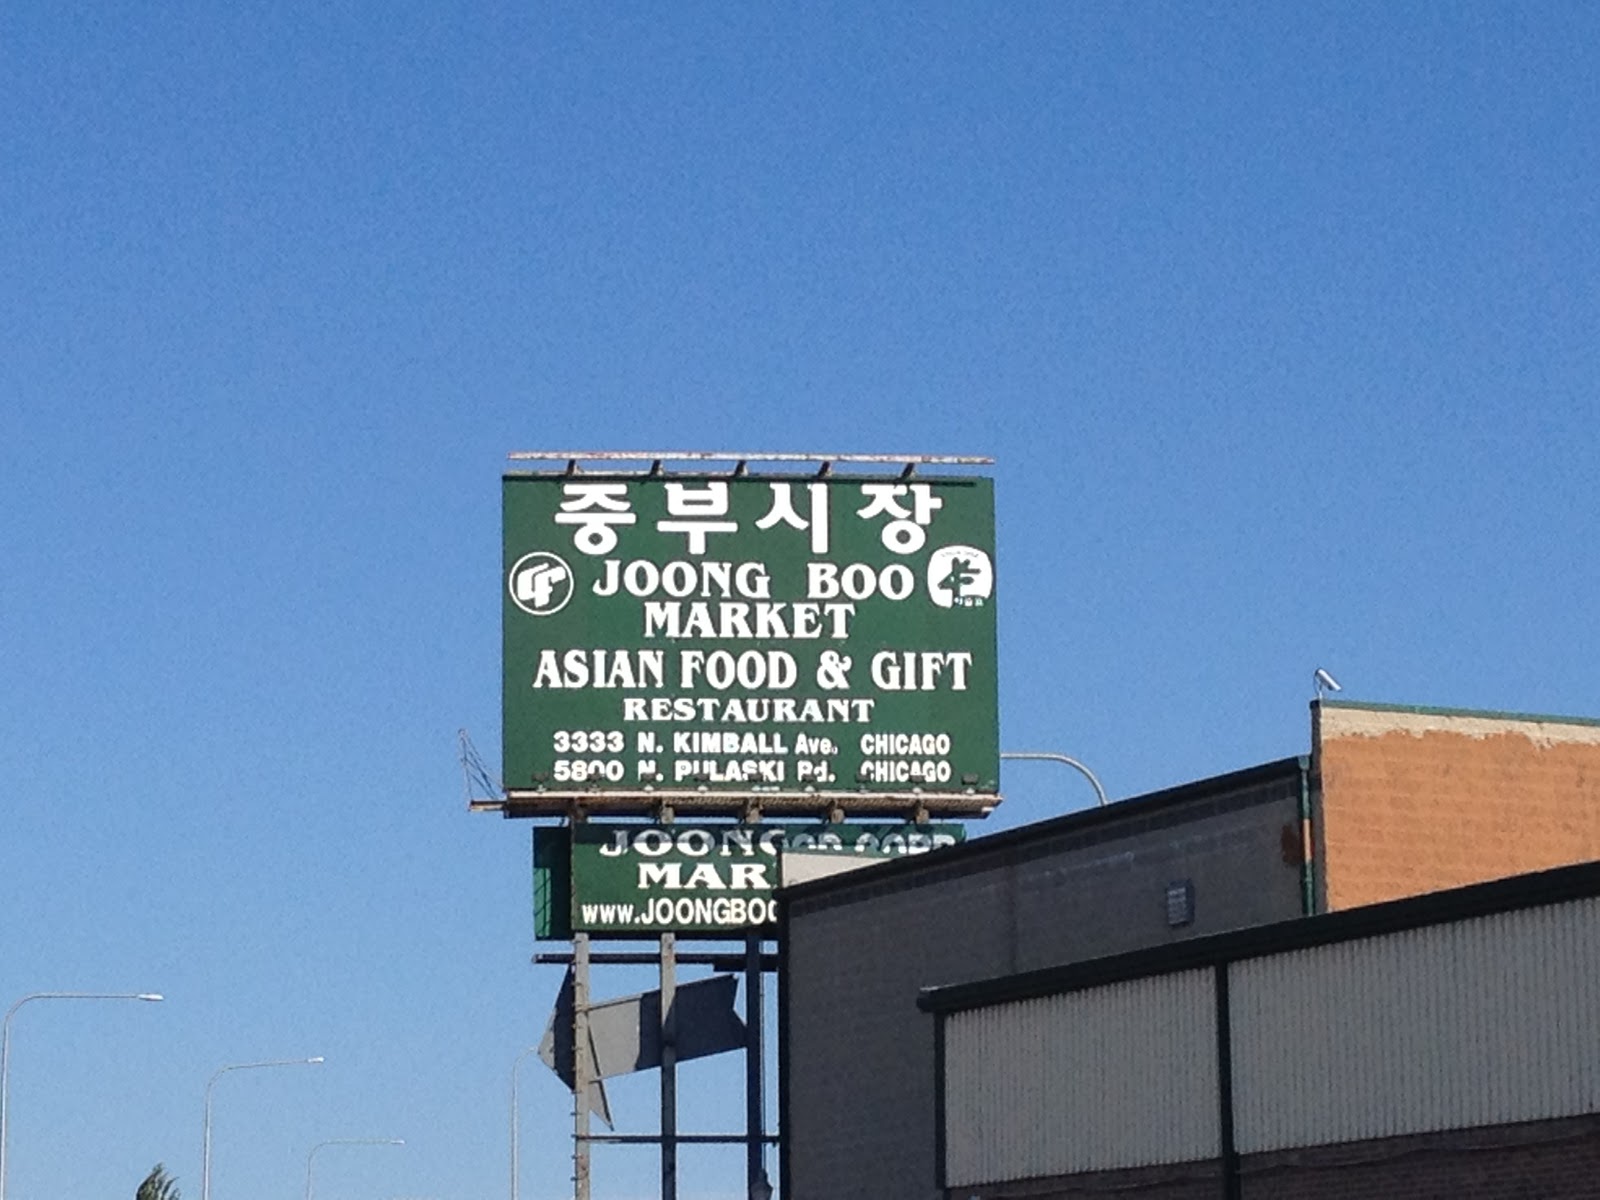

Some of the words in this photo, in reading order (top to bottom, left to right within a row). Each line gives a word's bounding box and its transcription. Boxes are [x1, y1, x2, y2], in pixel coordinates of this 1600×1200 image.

[554, 481, 944, 556] 중부시장
[592, 559, 771, 599] JOONG
[807, 562, 915, 601] BOO
[644, 601, 856, 639] MARKET
[532, 649, 664, 689] ASIAN
[680, 649, 797, 690] FOOD
[816, 649, 852, 690] &
[871, 650, 972, 691] GIFT
[623, 697, 875, 723] RESTAURANT
[553, 730, 625, 753] 3333
[637, 731, 664, 754] N.
[673, 731, 789, 755] KIMBALL
[860, 733, 951, 756] CHICAGO
[553, 759, 625, 782] 5800
[674, 759, 785, 783] PULASKI
[860, 759, 952, 783] CHICAGO
[637, 862, 777, 890] MAR
